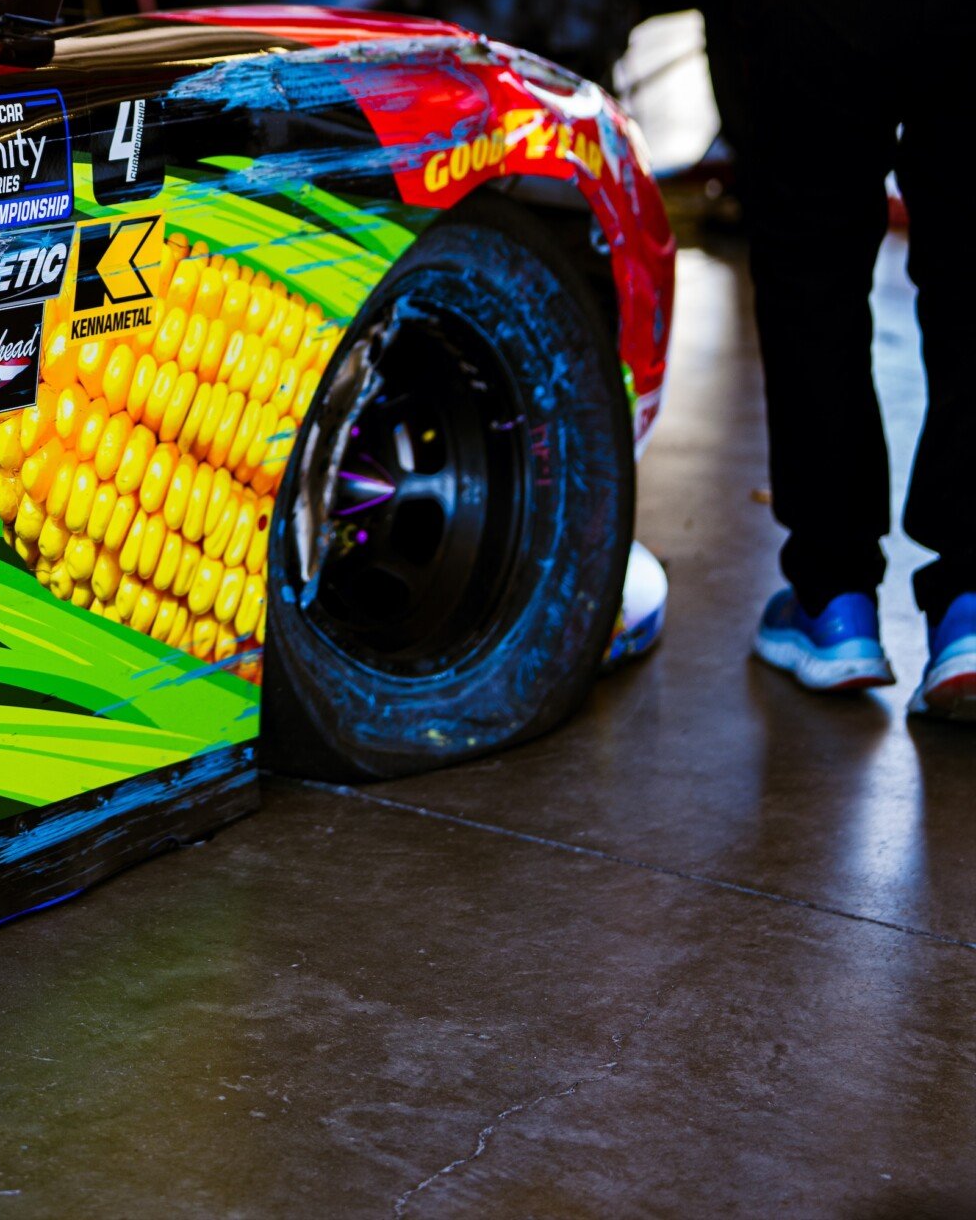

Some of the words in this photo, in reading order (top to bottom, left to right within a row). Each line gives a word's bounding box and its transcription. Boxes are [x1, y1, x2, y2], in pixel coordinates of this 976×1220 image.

[108, 99, 145, 182] 4
[130, 101, 145, 179] CHAMPIONSHIP
[71, 306, 152, 340] KENNAMETAL
